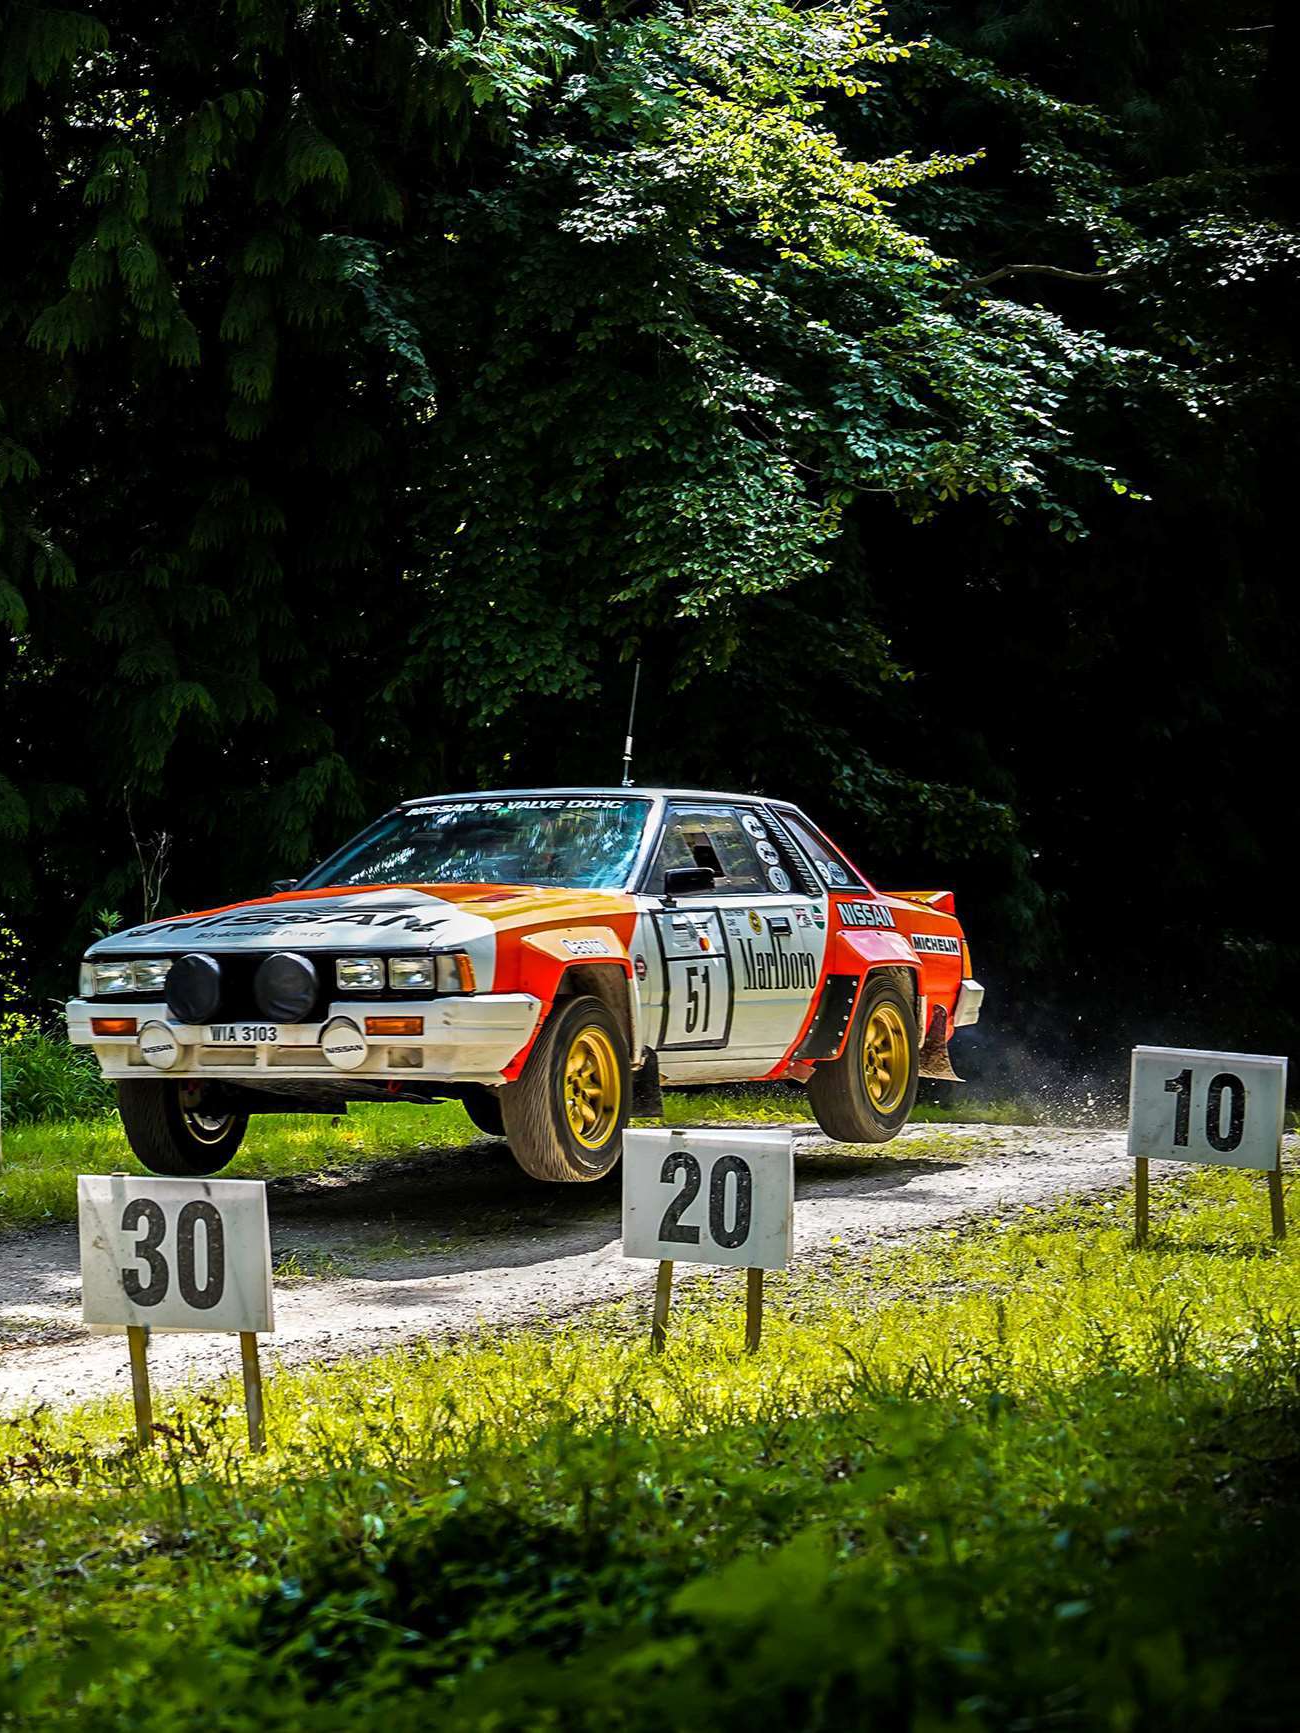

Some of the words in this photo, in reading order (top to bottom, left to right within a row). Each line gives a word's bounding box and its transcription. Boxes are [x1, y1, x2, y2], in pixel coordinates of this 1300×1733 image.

[405, 803, 480, 816] NISSAN
[481, 802, 503, 811] 16
[507, 800, 565, 810] VALVE
[566, 800, 624, 809] DOHC
[125, 912, 452, 938] NISSAN
[836, 903, 896, 928] NISSAN
[736, 916, 817, 991] Marlboro
[912, 936, 959, 953] MICHELIN
[685, 965, 710, 1033] 51
[210, 1026, 237, 1041] WIA
[242, 1026, 278, 1041] 3103
[141, 1044, 174, 1053] NISSAN
[324, 1045, 364, 1054] NISSAN
[1164, 1069, 1246, 1153] 10
[658, 1151, 752, 1249] 20
[121, 1198, 225, 1310] 30
